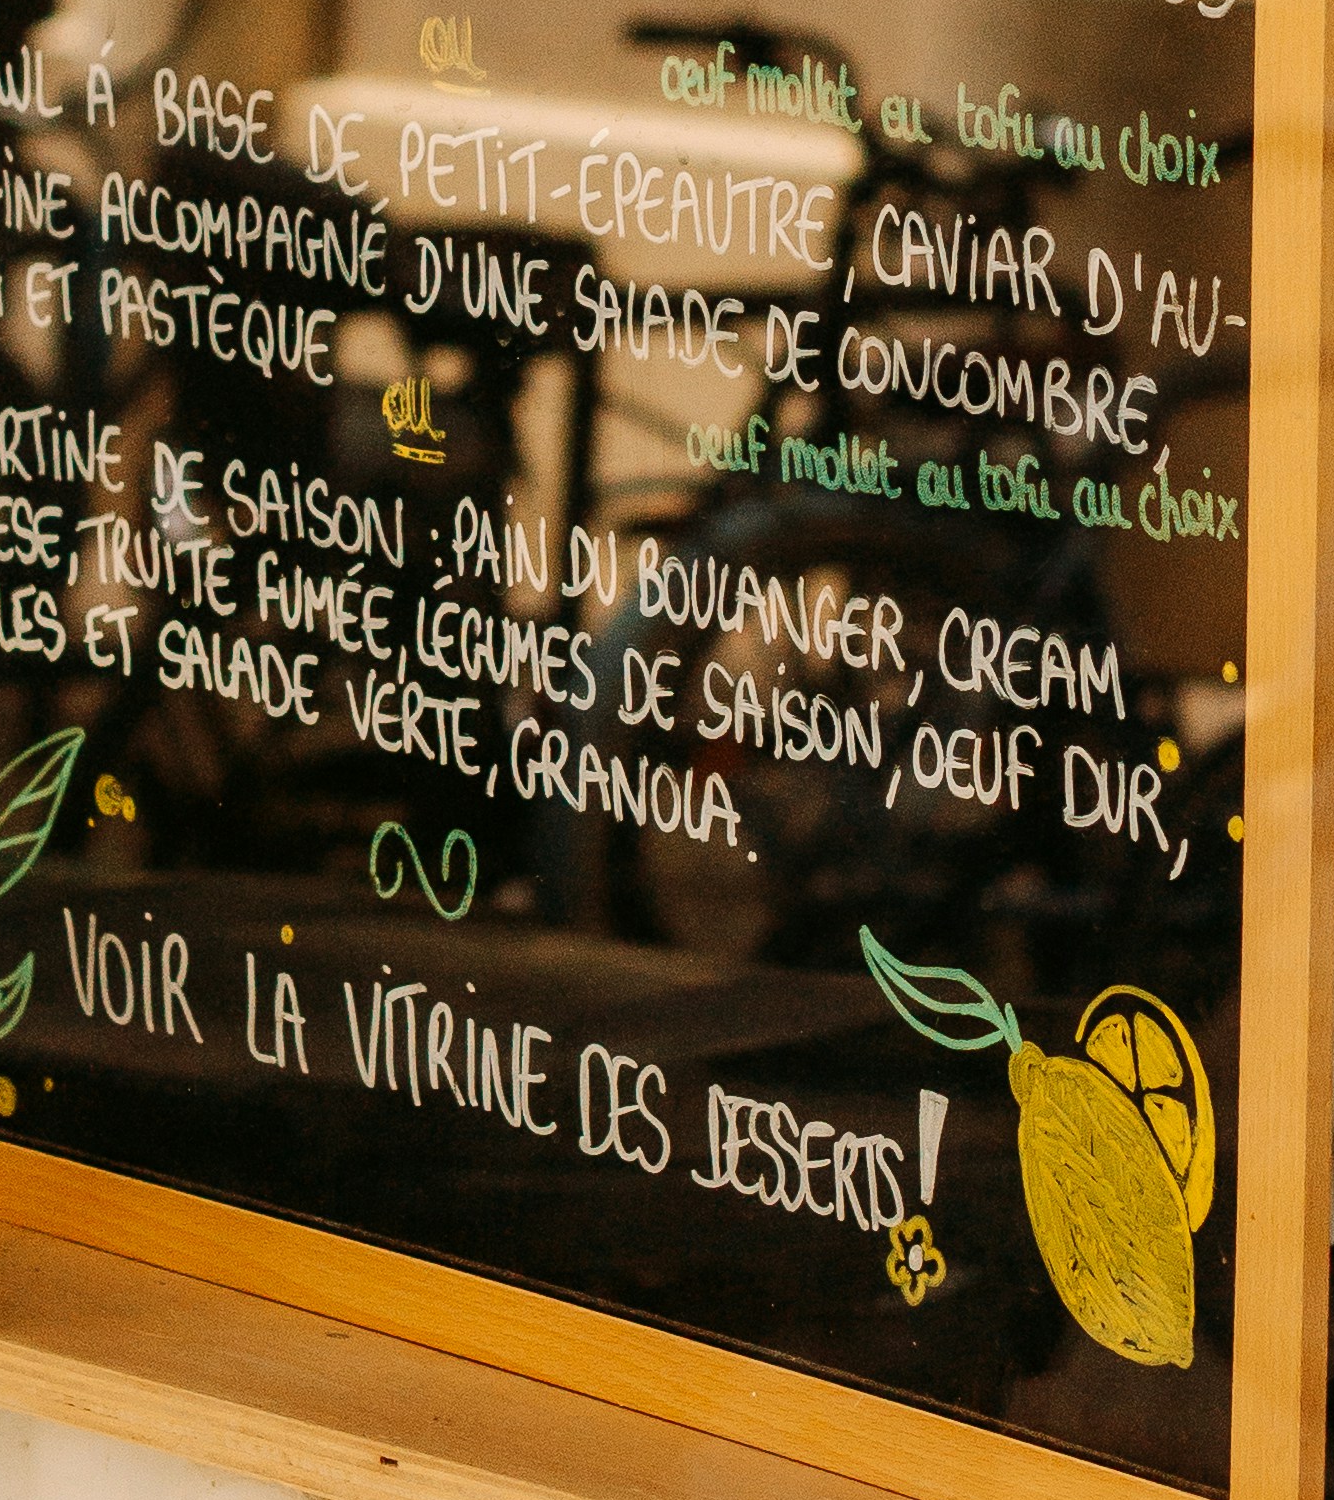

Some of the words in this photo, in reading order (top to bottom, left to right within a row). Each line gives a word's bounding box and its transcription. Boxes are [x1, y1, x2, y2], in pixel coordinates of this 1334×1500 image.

[152, 66, 275, 164] BASE
[304, 102, 369, 197] DE
[872, 203, 1062, 318] CAVIAR
[957, 81, 1045, 161] tofu
[1118, 109, 1222, 189] choix
[24, 260, 80, 329] ET
[99, 264, 338, 386] PASTÈQUE
[101, 171, 390, 298] ACCOMPAGNÉ
[405, 236, 551, 335] D'UNE
[573, 263, 744, 380] SALADE
[764, 303, 822, 393] DE
[837, 325, 1170, 474] CONCOMBRE,
[151, 441, 211, 526] DE
[221, 459, 406, 569] SAISON
[451, 494, 549, 594] PAIN
[561, 524, 617, 607] DU
[637, 537, 926, 709] BOULANGER,
[937, 606, 1127, 721] CREAM
[780, 432, 902, 499] mollet
[978, 449, 1061, 521] tofu
[1072, 476, 1133, 531] au
[1138, 467, 1242, 543] choix
[77, 512, 238, 617] TRUITE
[256, 561, 408, 684] FUMÉE,
[416, 574, 597, 710] LÉGUMES
[618, 646, 676, 730] DE
[912, 723, 1044, 810] OEUF
[1062, 745, 1190, 882] DUR,
[84, 603, 139, 676] ET
[158, 619, 320, 726] SALADE
[347, 669, 498, 800] VERTE,
[509, 715, 759, 864] GRANOLA.
[63, 907, 204, 1045] VOIR
[243, 952, 309, 1075] LA
[343, 963, 559, 1137] VITRINE
[578, 1043, 670, 1174] DES
